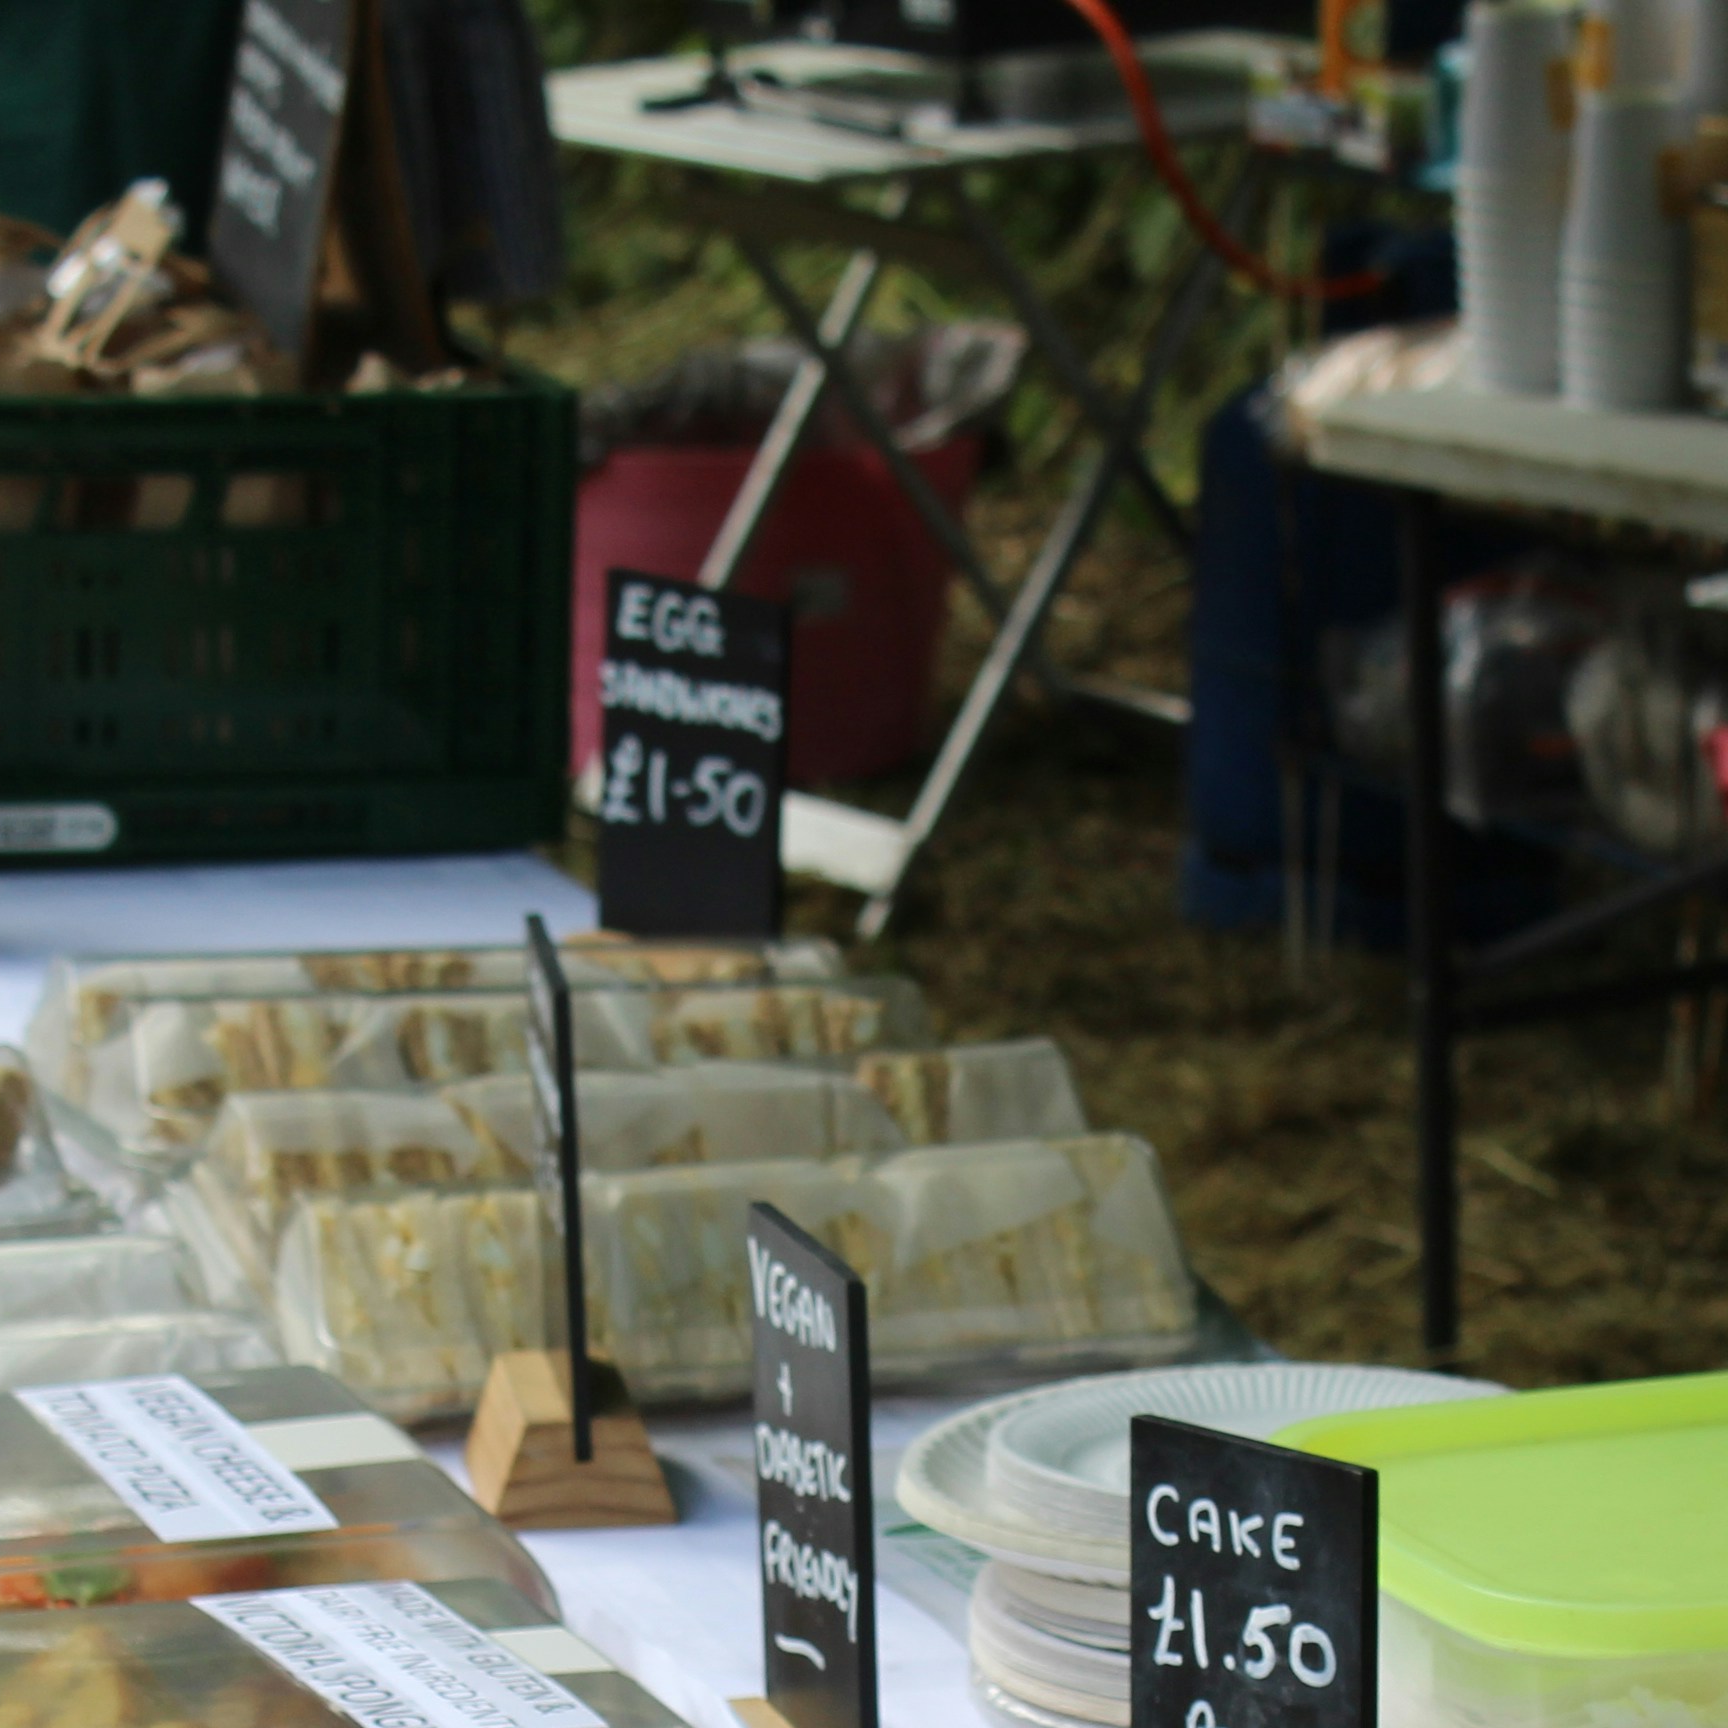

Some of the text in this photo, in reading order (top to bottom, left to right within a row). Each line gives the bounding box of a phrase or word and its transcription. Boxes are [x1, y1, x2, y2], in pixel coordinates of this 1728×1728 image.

[616, 582, 725, 657] EGG
[747, 1237, 838, 1352] VEGAN
[50, 1391, 202, 1513] TOMATO PIZZA
[128, 1383, 222, 1440] VEGAN
[193, 1442, 298, 1505] CHEESE
[763, 1519, 860, 1642] FRIENDLY
[1147, 1484, 1304, 1570] CAKE
[217, 1599, 347, 1671] VICTORIA
[383, 1585, 447, 1619] MADE
[423, 1620, 484, 1650] WITH
[468, 1653, 556, 1702] GLUTEN
[1148, 1575, 1336, 1688] £1.50
